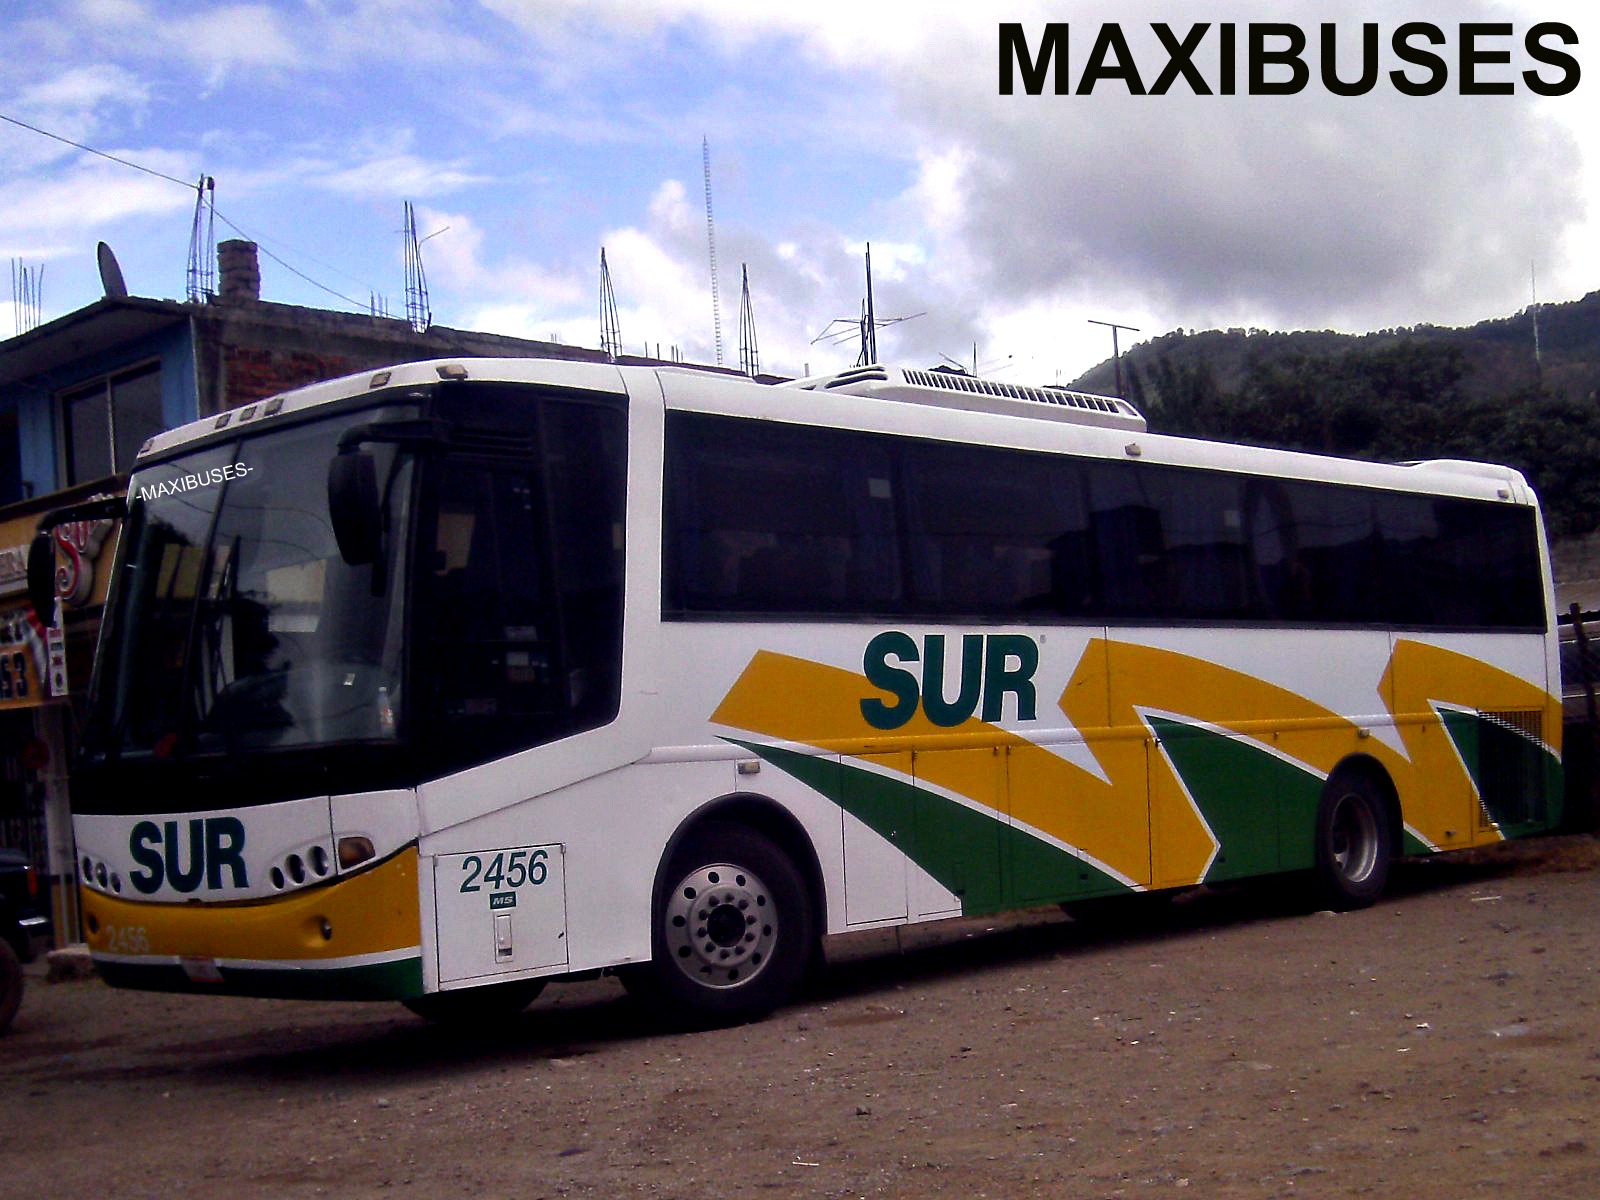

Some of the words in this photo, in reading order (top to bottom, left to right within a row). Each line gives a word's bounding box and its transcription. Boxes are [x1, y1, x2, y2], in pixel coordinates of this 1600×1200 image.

[860, 631, 1039, 730] SUR
[129, 816, 250, 895] SUR
[460, 850, 548, 893] 2456
[105, 925, 150, 953] 2456
